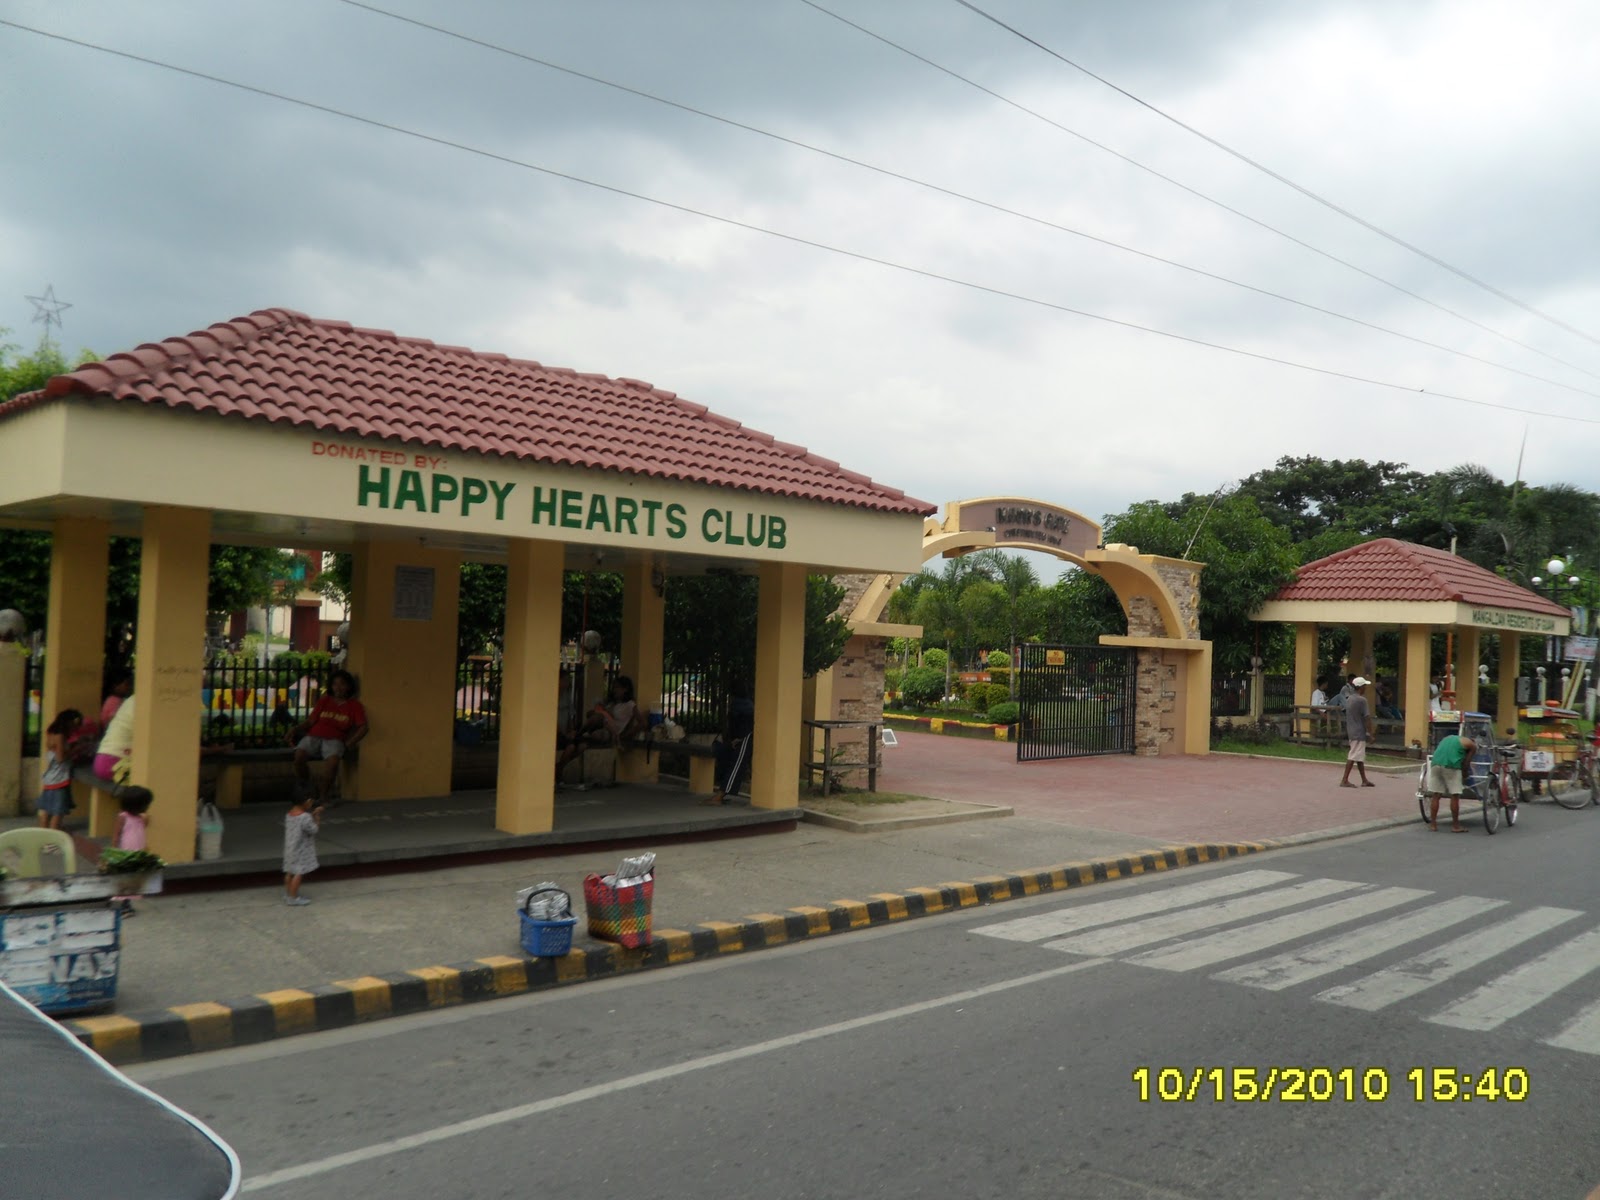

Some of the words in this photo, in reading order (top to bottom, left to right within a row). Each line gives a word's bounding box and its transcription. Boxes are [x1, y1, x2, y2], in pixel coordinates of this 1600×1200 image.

[311, 440, 407, 465] DONATED
[357, 464, 516, 521] HAPPY
[531, 485, 687, 539] HEARTS
[701, 508, 787, 550] CLUB
